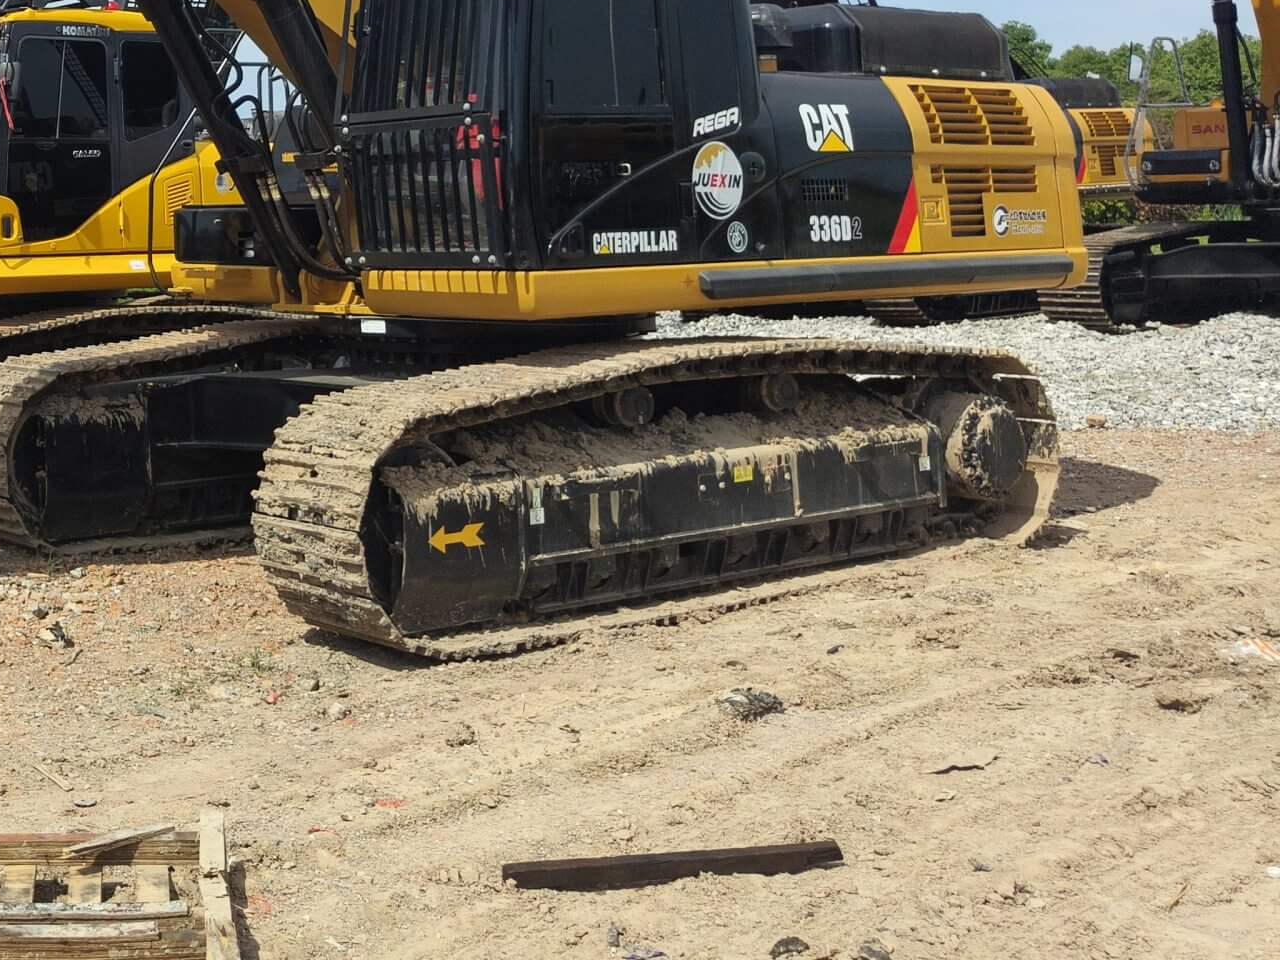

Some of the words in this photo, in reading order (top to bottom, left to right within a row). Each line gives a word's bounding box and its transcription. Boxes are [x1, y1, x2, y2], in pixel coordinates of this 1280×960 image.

[692, 106, 739, 138] REGA
[798, 103, 855, 152] CAT
[1192, 124, 1226, 135] SAN
[695, 172, 742, 190] JUEXIN
[809, 214, 863, 242] 336D2
[592, 230, 678, 255] CATERPILLAR
